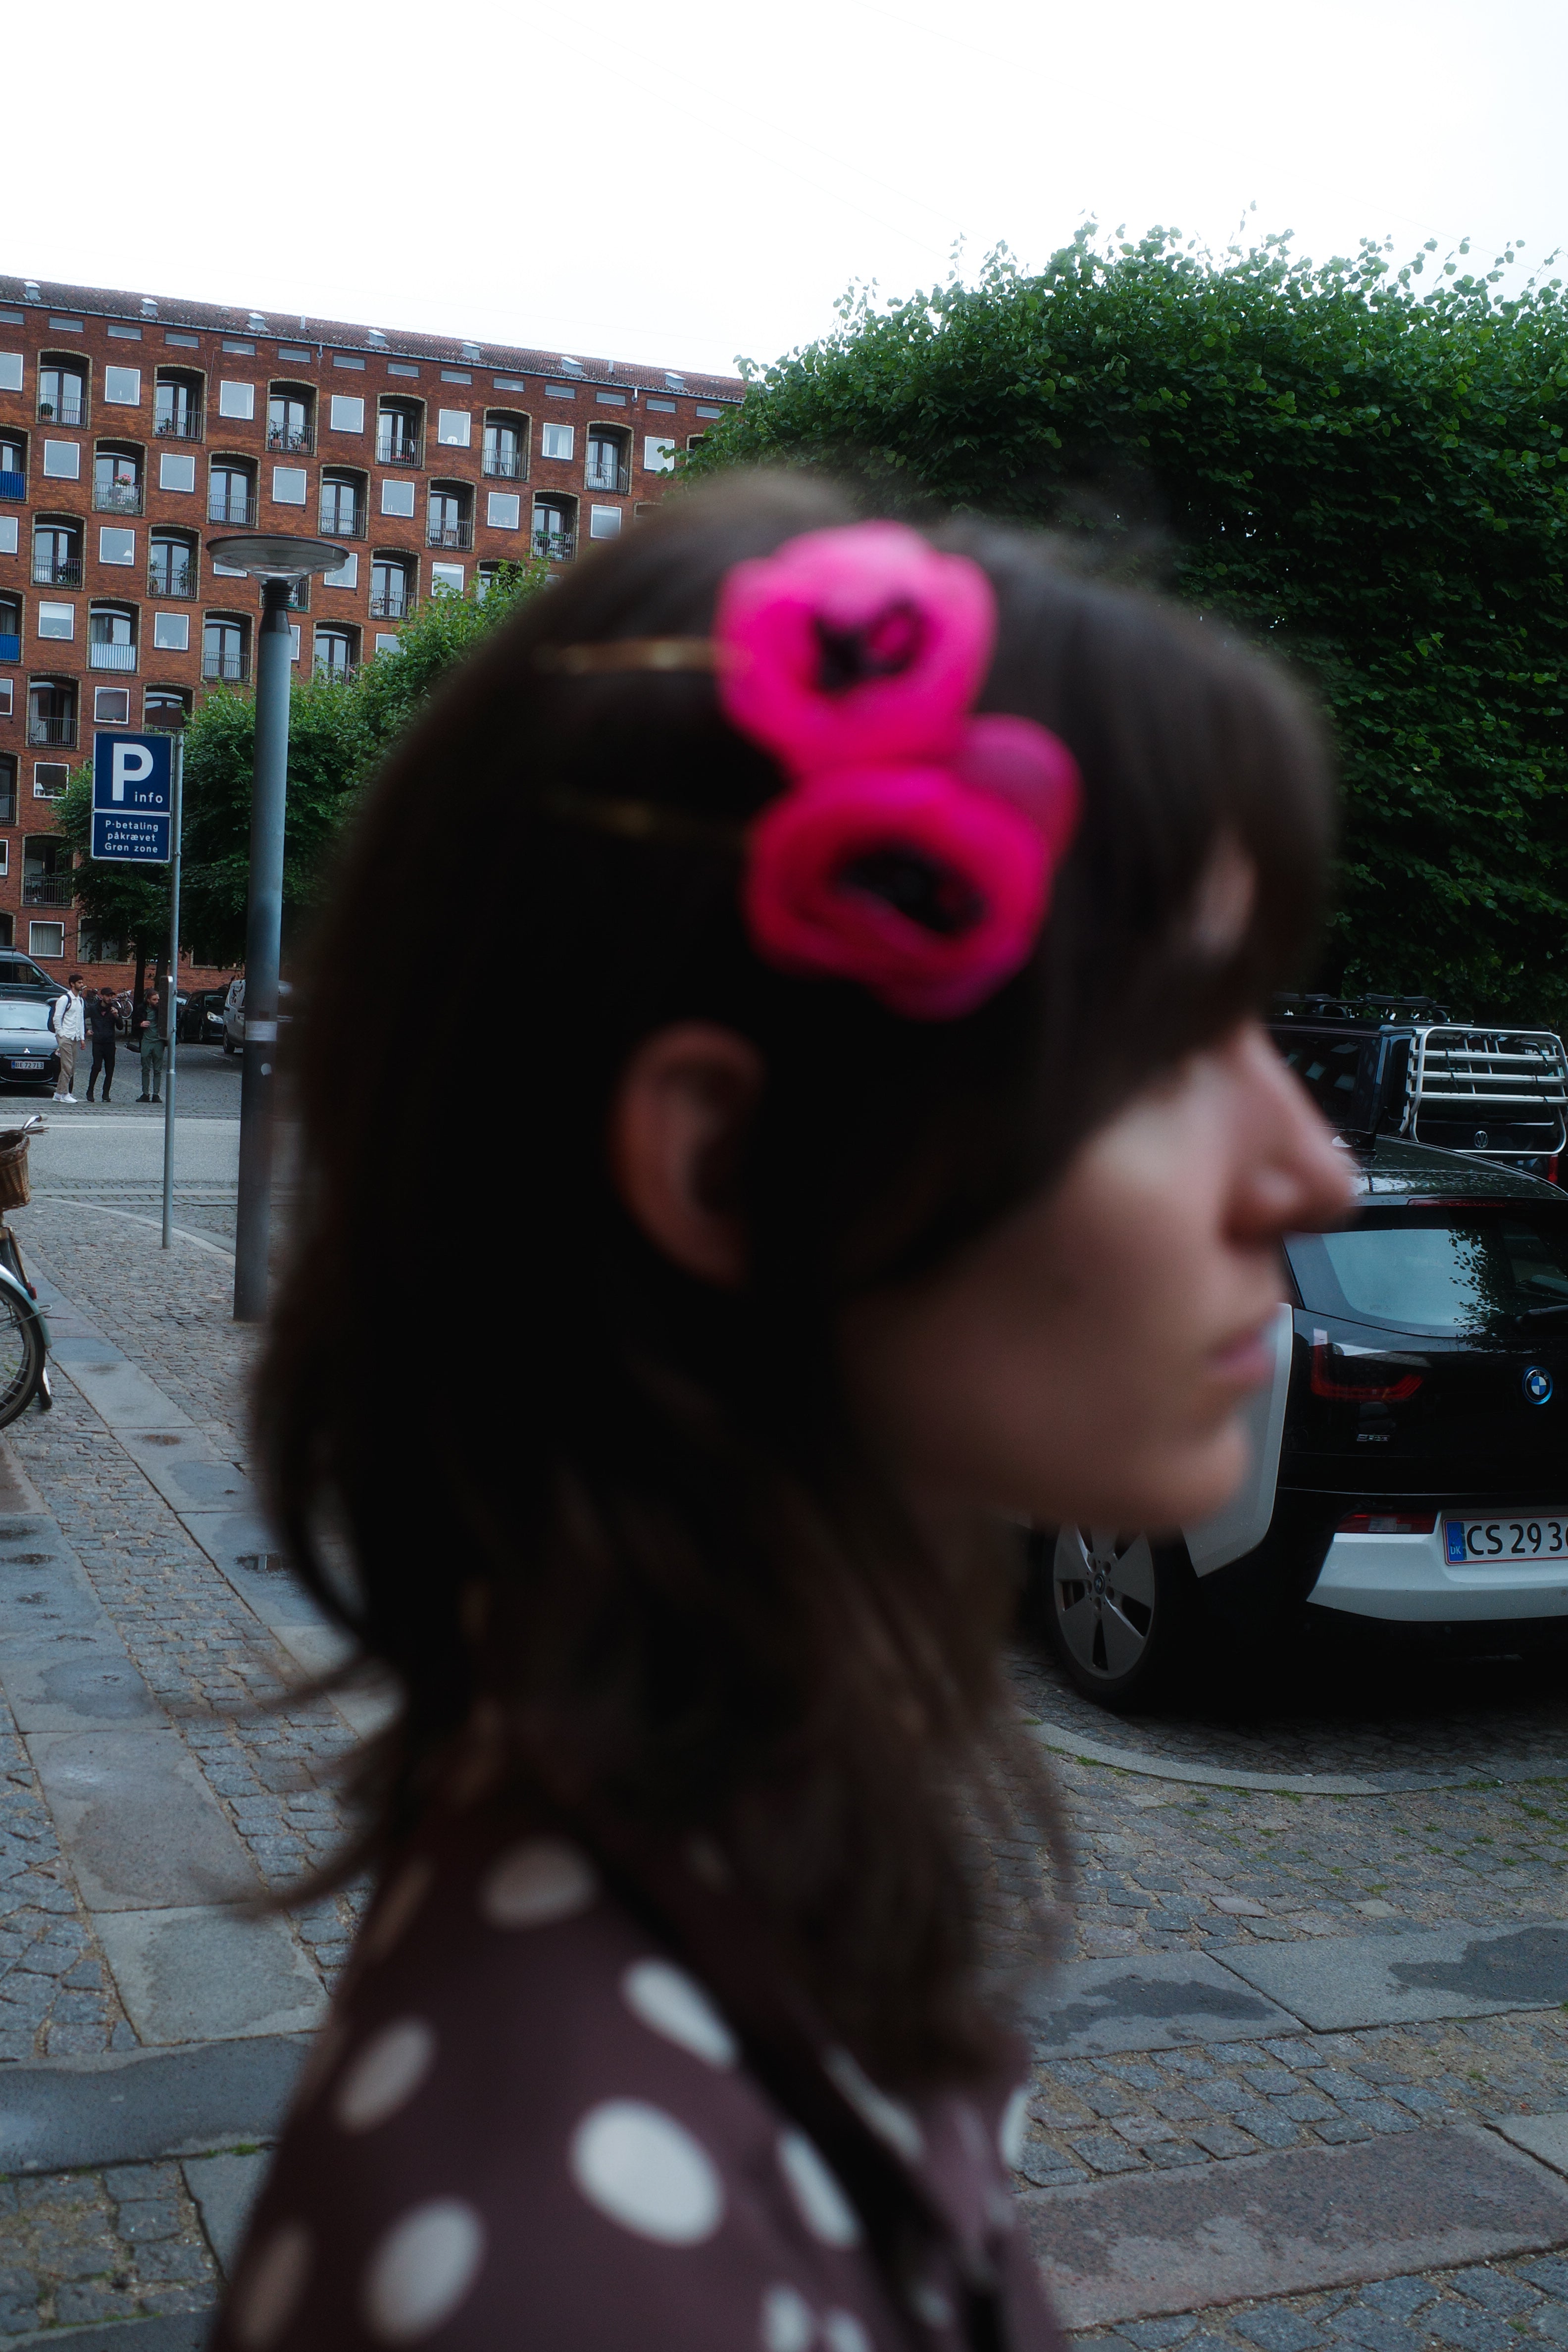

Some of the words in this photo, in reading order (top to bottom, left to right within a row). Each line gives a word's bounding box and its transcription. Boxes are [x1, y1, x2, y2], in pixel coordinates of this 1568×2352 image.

[112, 743, 153, 801] P
[134, 792, 163, 803] info
[105, 820, 158, 832] P-betaling
[107, 832, 155, 842] påkrævet
[104, 843, 129, 852] Grøn
[1467, 1525, 1503, 1555] CS
[1509, 1523, 1542, 1553] 29
[1548, 1522, 1568, 1551] 3
[1450, 1546, 1461, 1555] DK
